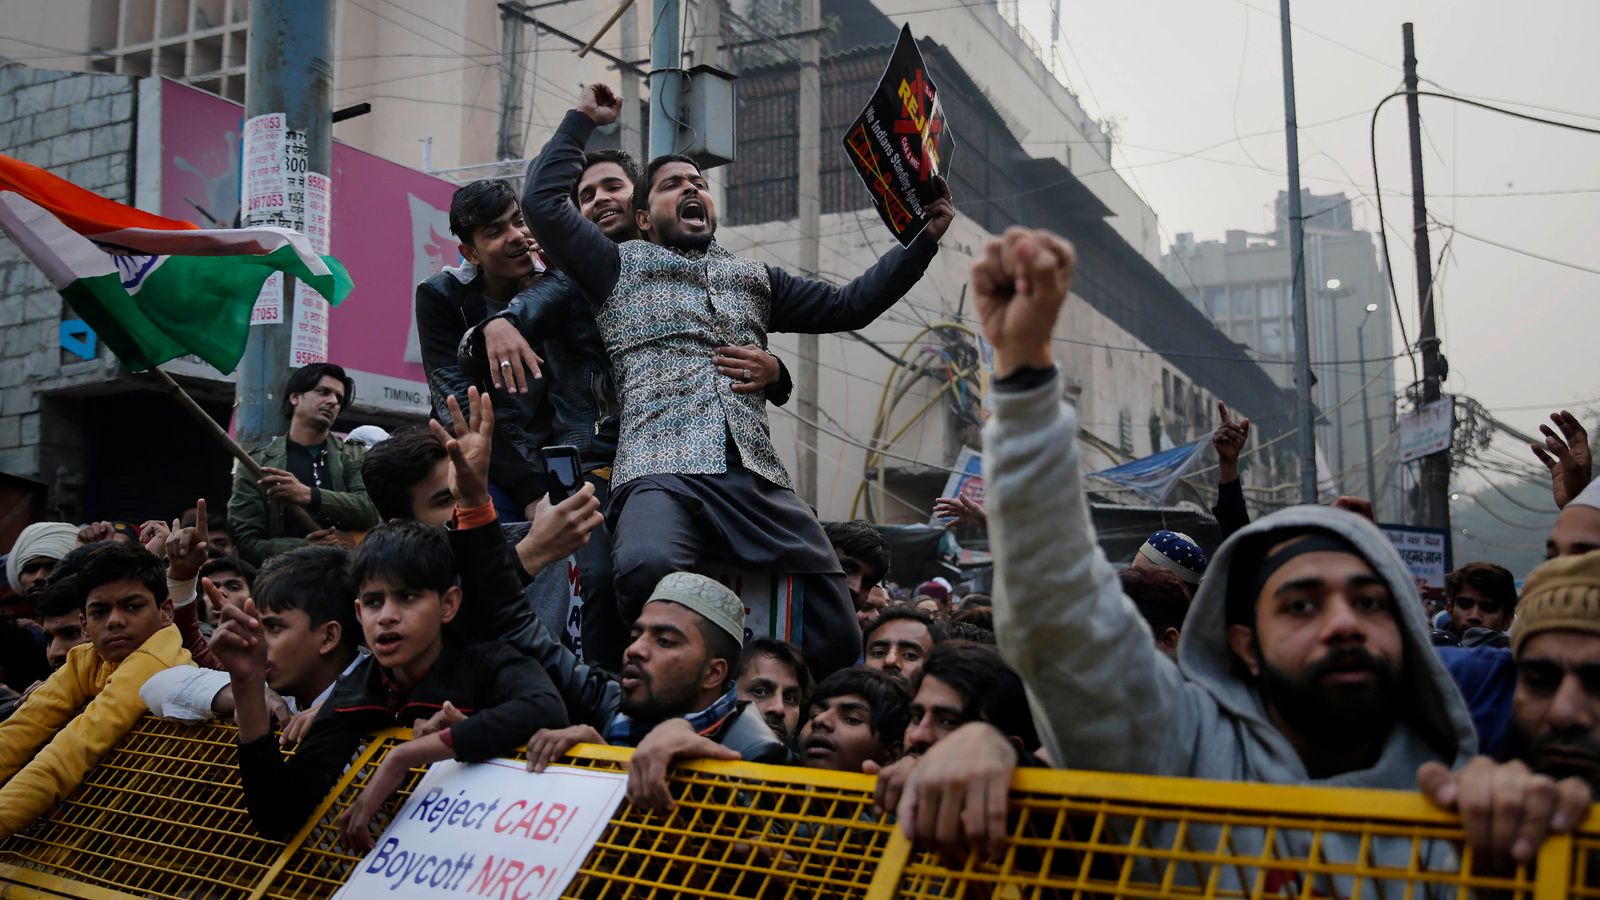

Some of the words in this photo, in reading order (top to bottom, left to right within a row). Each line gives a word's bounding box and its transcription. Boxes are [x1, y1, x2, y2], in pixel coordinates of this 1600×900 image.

[865, 104, 876, 124] We
[871, 119, 894, 157] Indians
[891, 152, 911, 192] Standing
[905, 187, 927, 221] Against
[409, 787, 501, 833] Reject
[493, 799, 580, 844] CAB!
[365, 837, 475, 891] Boycott
[466, 853, 558, 900] NRC!
